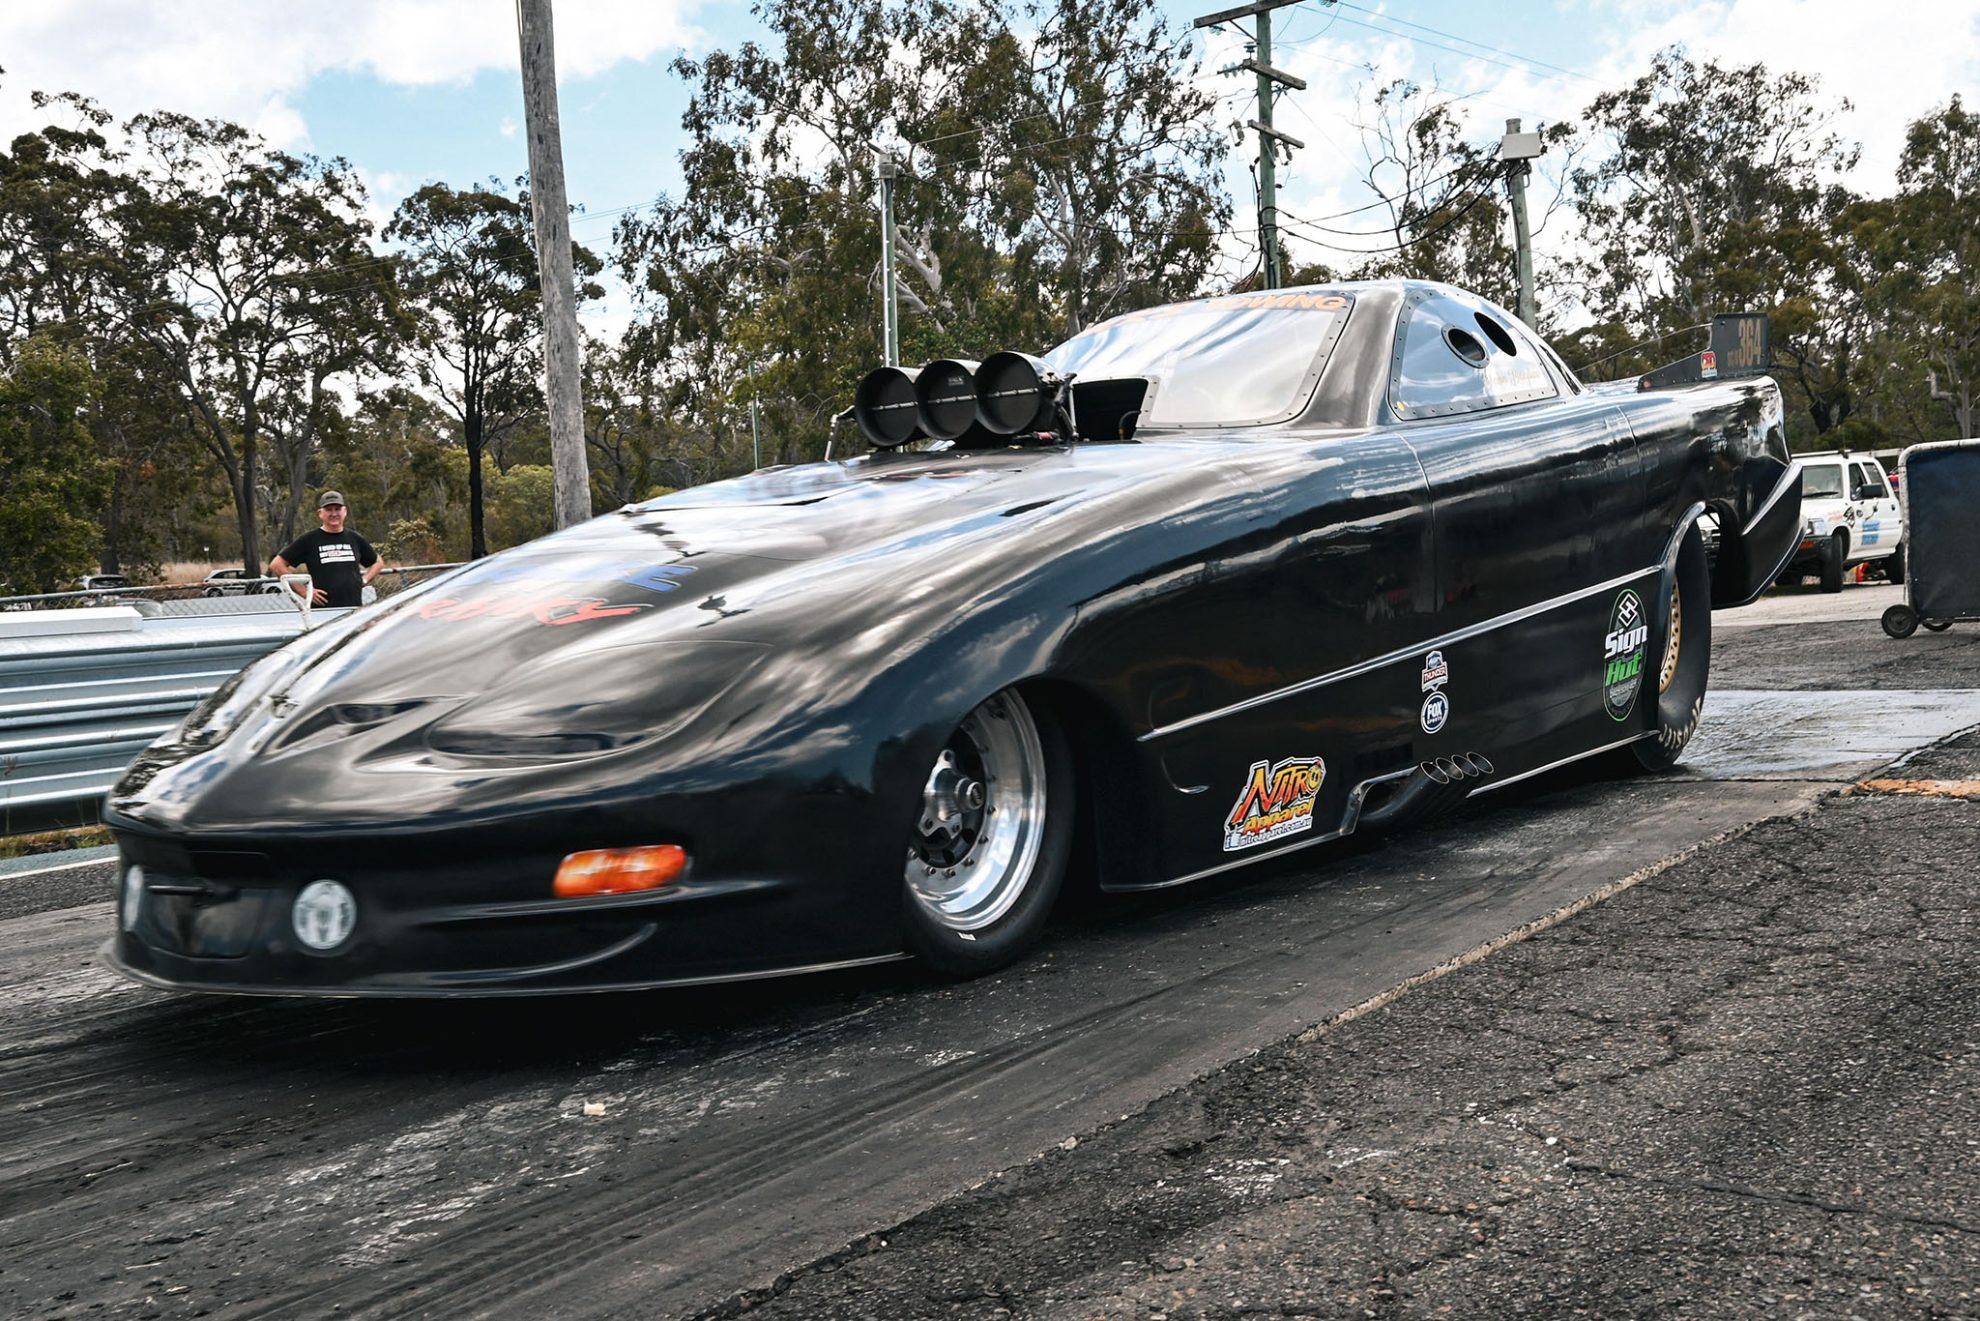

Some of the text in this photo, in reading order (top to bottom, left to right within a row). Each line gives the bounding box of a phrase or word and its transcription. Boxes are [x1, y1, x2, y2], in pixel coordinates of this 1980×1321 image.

[1604, 625, 1648, 659] Sign
[1605, 653, 1643, 687] Hut
[1427, 701, 1442, 720] FOX
[1242, 798, 1313, 835] Apparel
